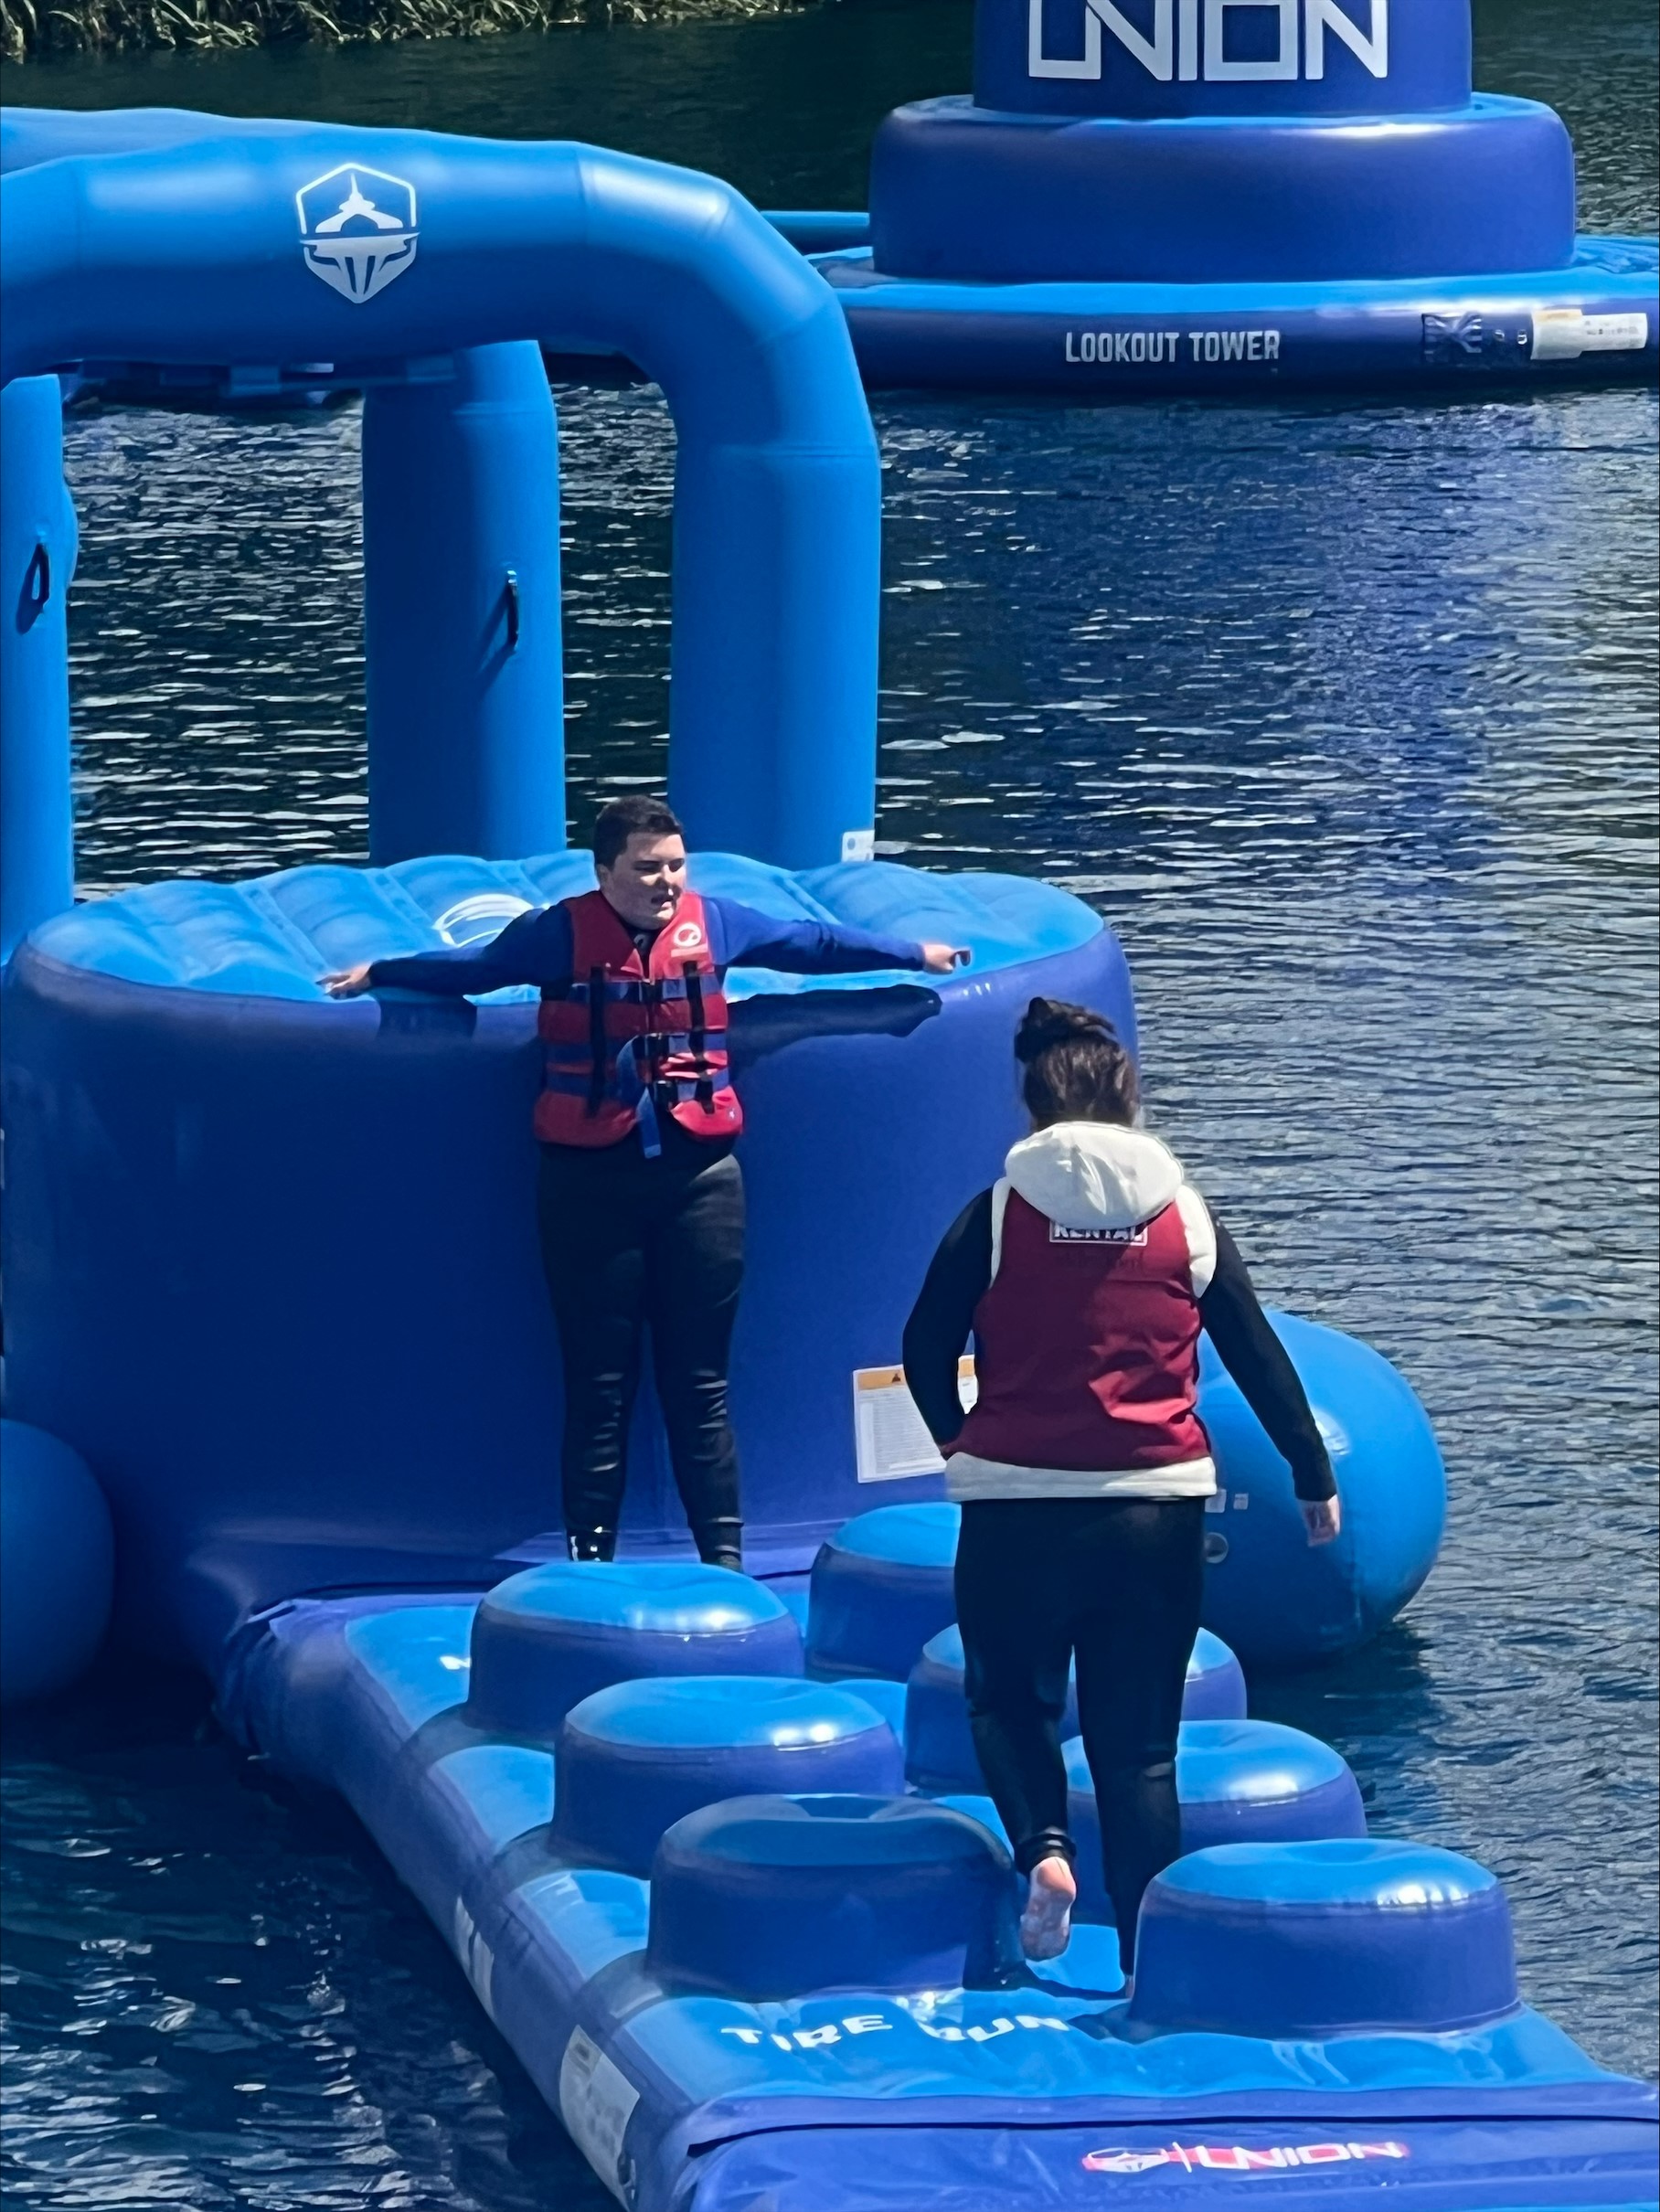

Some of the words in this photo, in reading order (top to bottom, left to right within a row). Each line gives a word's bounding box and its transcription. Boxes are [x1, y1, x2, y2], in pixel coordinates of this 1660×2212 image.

[1028, 0, 1389, 81] UNION
[1065, 331, 1180, 363] LOOKOUT
[1187, 329, 1281, 362] TOWER
[720, 2015, 893, 2051] TIRE
[1196, 2142, 1402, 2170] UNION
